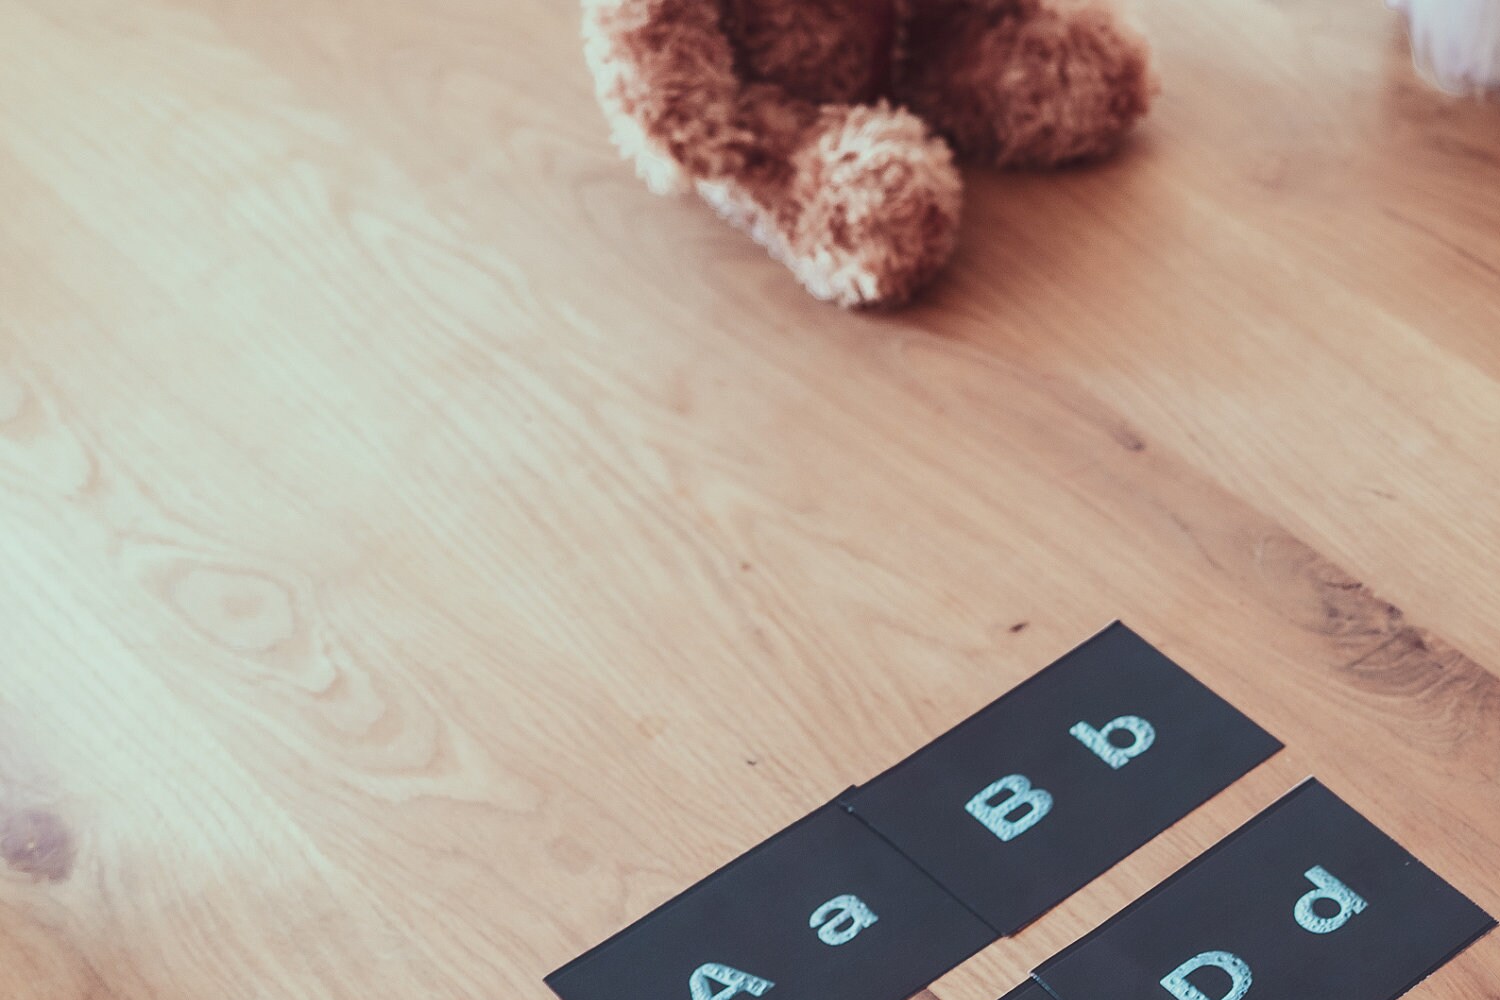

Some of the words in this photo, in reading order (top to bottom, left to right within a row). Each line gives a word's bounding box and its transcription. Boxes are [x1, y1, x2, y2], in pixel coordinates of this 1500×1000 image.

[963, 773, 1054, 843] B
[1068, 714, 1157, 771] b
[808, 893, 880, 947] a
[1292, 864, 1370, 935] d
